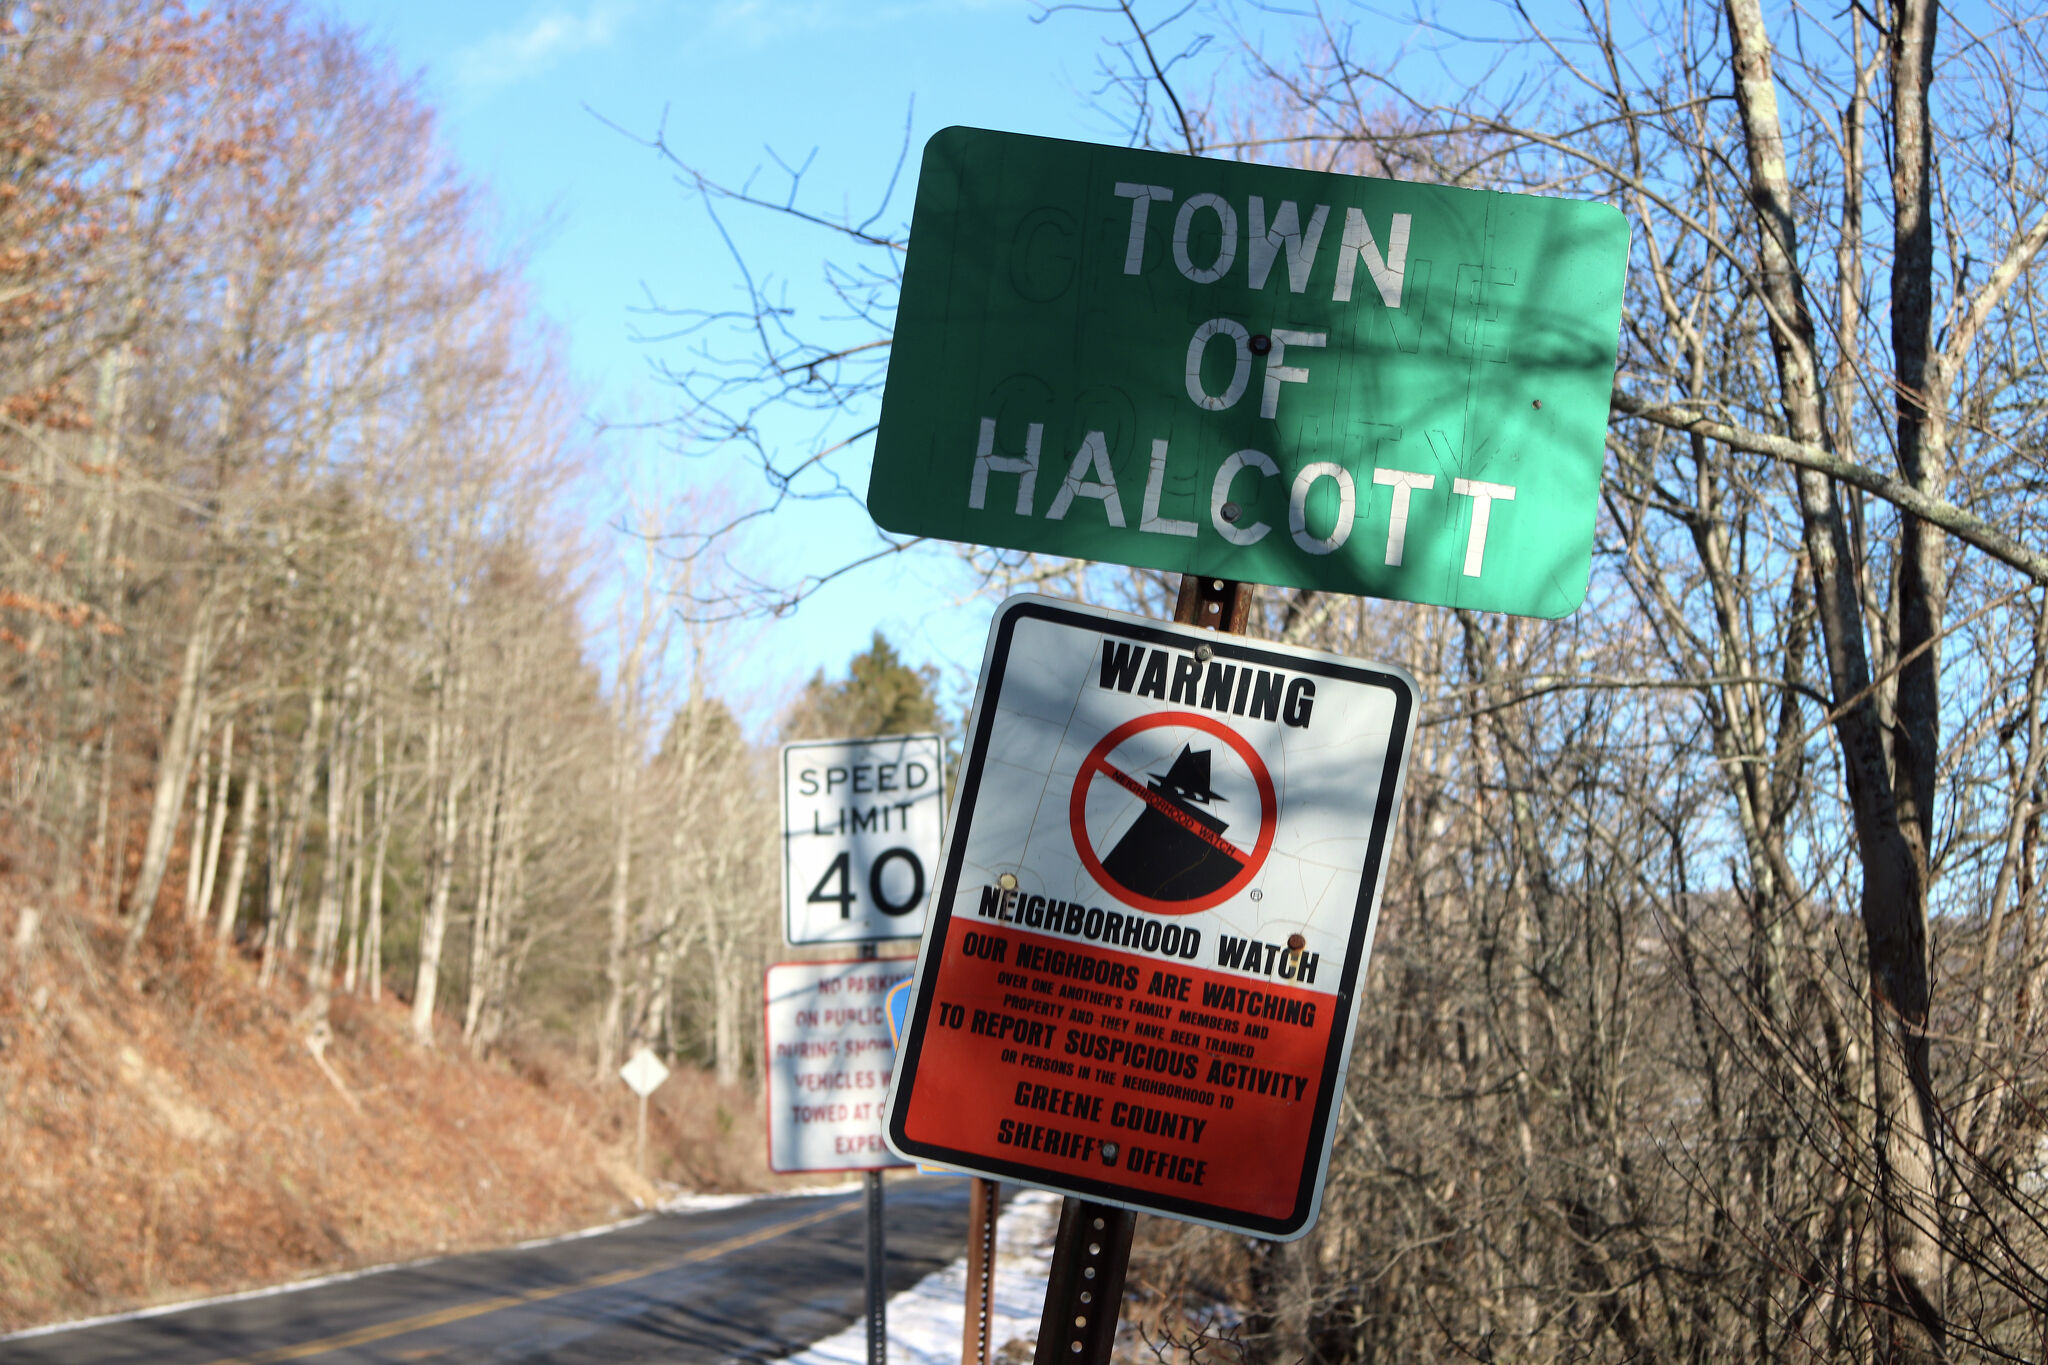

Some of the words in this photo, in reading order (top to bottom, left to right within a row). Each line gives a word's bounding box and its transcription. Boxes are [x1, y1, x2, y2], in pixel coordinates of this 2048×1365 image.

[1114, 182, 1412, 308] TOWN
[1186, 317, 1327, 419] OF
[969, 417, 1516, 577] HALCOTT
[1100, 640, 1316, 729] WARNING
[800, 762, 928, 796] SPEED
[814, 802, 913, 836] LIMIT
[1112, 771, 1194, 828] NEIGHBORHOOD
[1199, 823, 1236, 856] WATCH
[807, 847, 925, 918] 40
[978, 885, 1201, 960] NEIGHBORHOOD
[1218, 934, 1319, 983] WATCH
[818, 976, 841, 994] NO
[847, 973, 911, 993] PARKI
[962, 932, 1008, 963] OUR
[1016, 943, 1140, 991] NEIGHBORS
[1147, 971, 1192, 1001] ARE
[1202, 981, 1316, 1028] WATCHING
[998, 972, 1027, 989] OVER
[1032, 979, 1053, 994] ONE
[1059, 984, 1123, 1009] ANOTHER'S
[1129, 998, 1172, 1019] FAMILY
[1179, 1010, 1239, 1033] MEMBERS
[1244, 1024, 1269, 1040] AND
[795, 1008, 818, 1028] ON
[824, 1006, 884, 1027] PUBLIC
[1003, 994, 1064, 1019] PROPERTY
[1069, 1008, 1094, 1025] AND
[1100, 1014, 1130, 1032] THEY
[1135, 1022, 1165, 1041] HAVE
[1170, 1029, 1200, 1048] BEEN
[1206, 1036, 1254, 1058] TRAINED
[794, 1071, 875, 1092] VEHICLES
[939, 1002, 965, 1029] TO
[971, 1009, 1057, 1049] REPORT
[1064, 1029, 1199, 1080] SUSPICIOUS
[1206, 1060, 1308, 1101] ACTIVITY
[1001, 1049, 1017, 1064] OR
[1021, 1053, 1074, 1077] PERSONS
[1078, 1065, 1091, 1081] IN
[1095, 1069, 1116, 1086] THE
[1122, 1075, 1215, 1107] NEIGHBORHOOD
[1220, 1095, 1235, 1110] TO
[792, 1103, 848, 1125] TOWED
[853, 1102, 871, 1120] AT
[1014, 1081, 1104, 1123] GREENE
[1110, 1101, 1208, 1144] COUNTY
[835, 1135, 889, 1155] EXPEN
[1126, 1146, 1209, 1187] OFFICE
